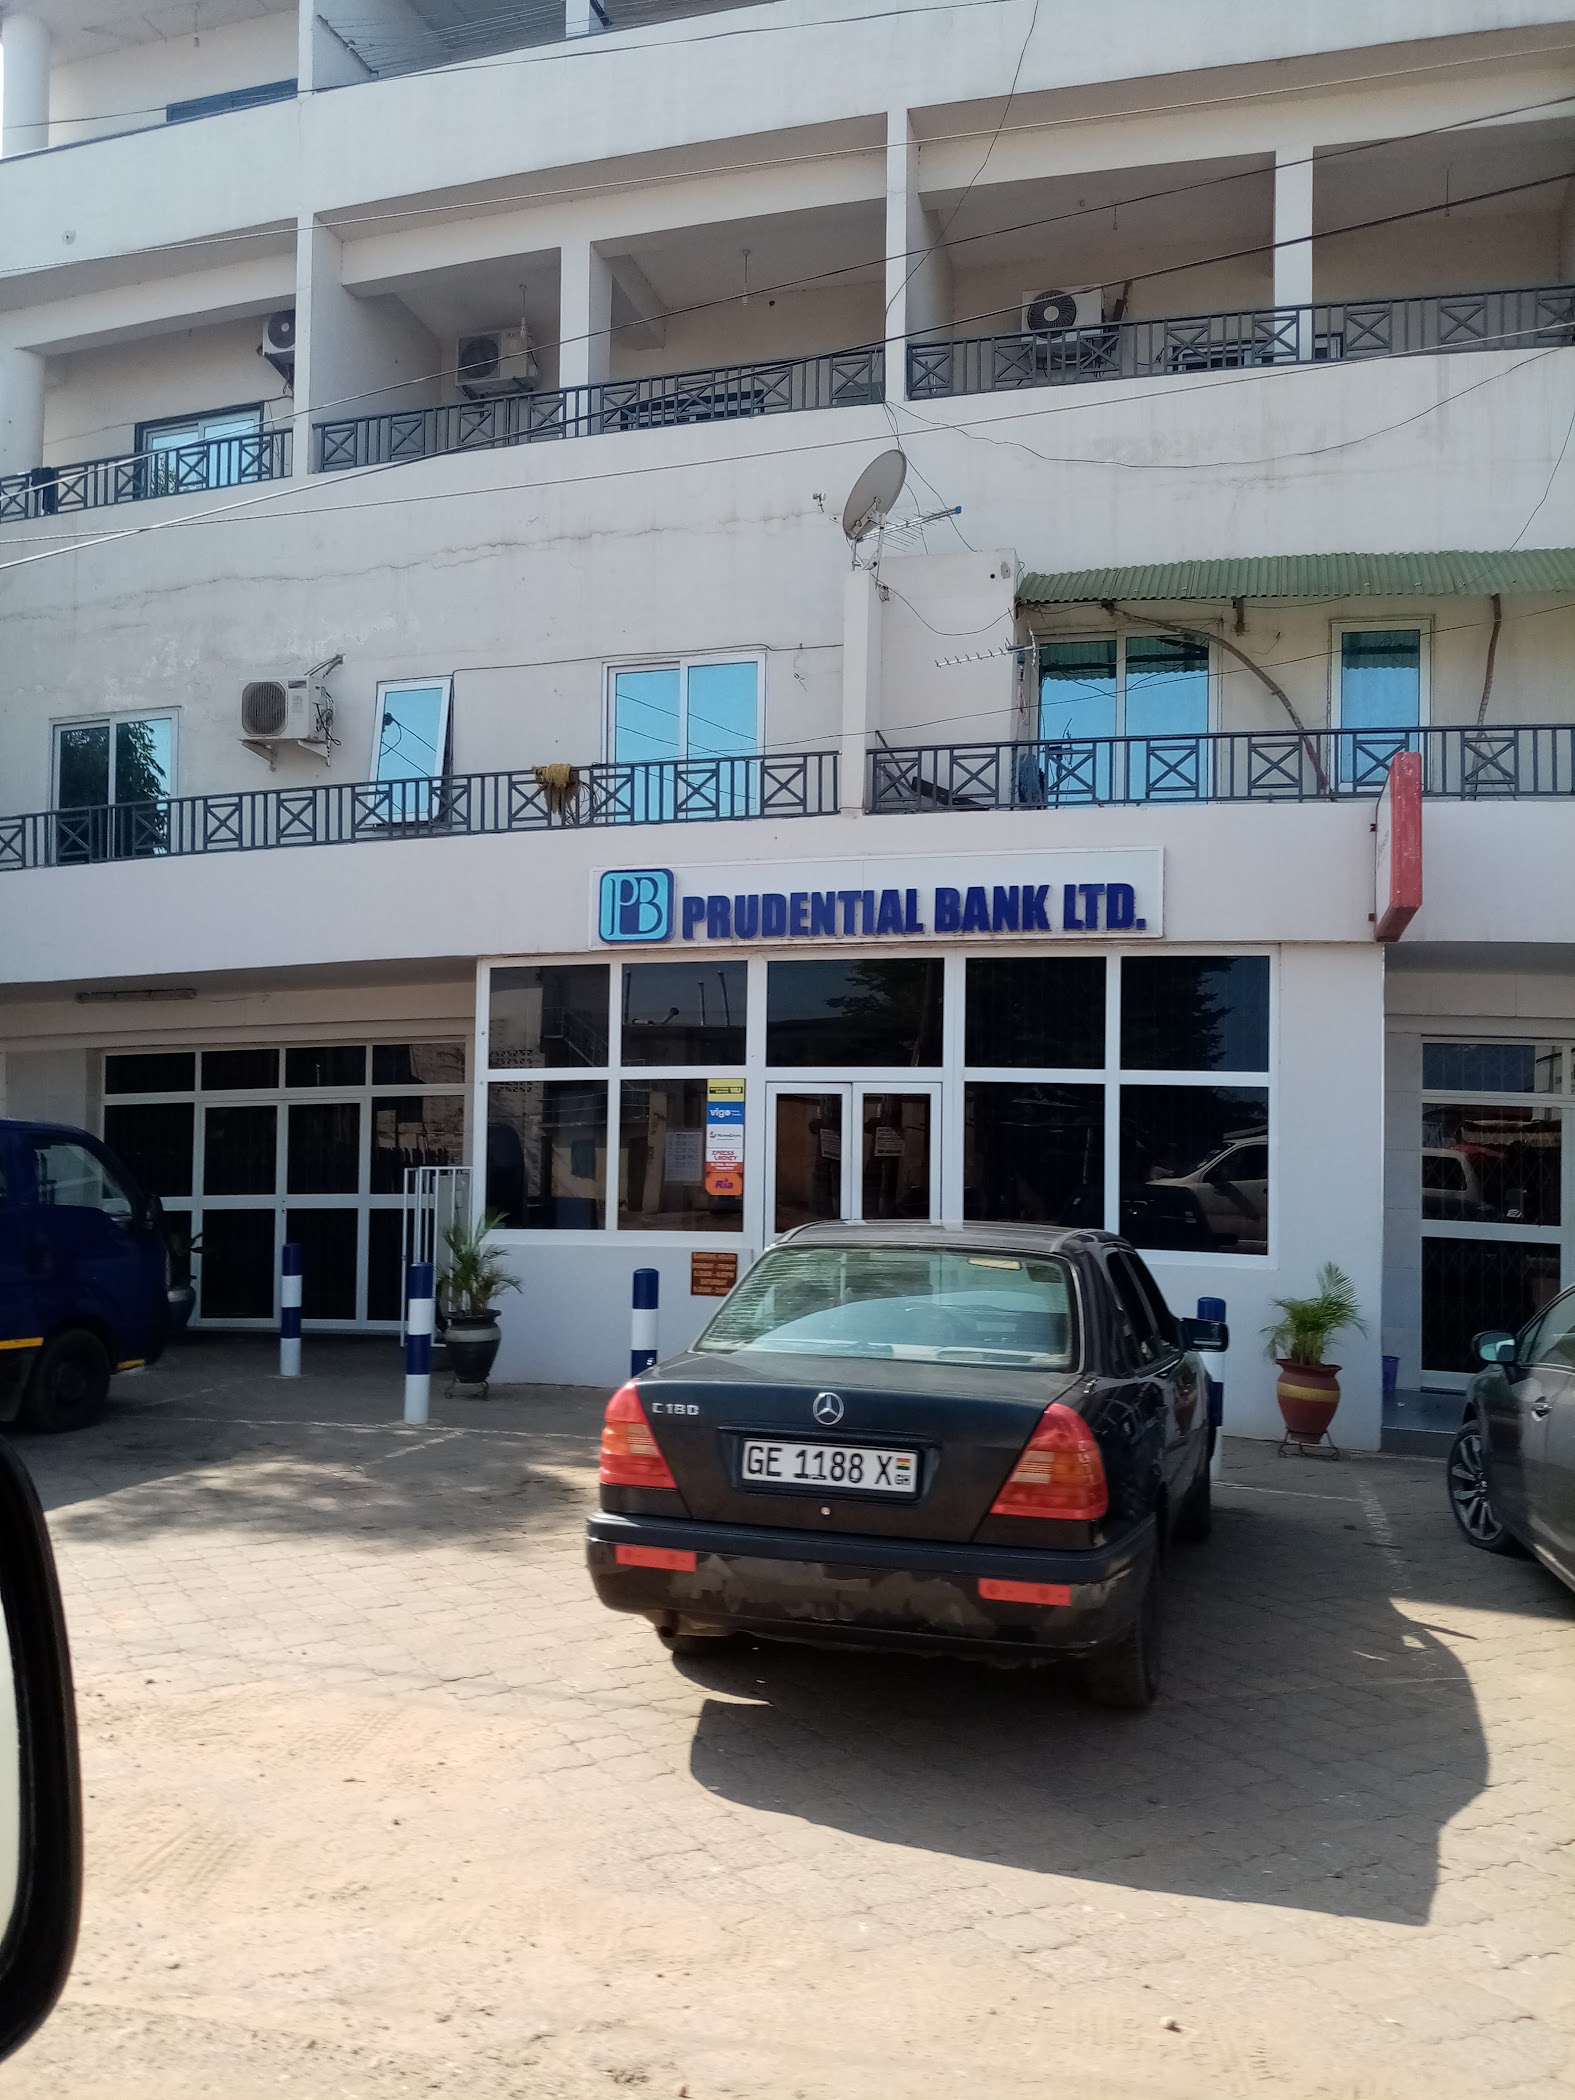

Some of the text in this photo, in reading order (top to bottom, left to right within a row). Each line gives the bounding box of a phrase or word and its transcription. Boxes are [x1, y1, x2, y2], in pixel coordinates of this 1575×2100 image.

[682, 883, 1146, 940] PRUDENTIAL BANK LTD.
[715, 1178, 734, 1189] Ria
[747, 1445, 893, 1485] GE 1188 X
